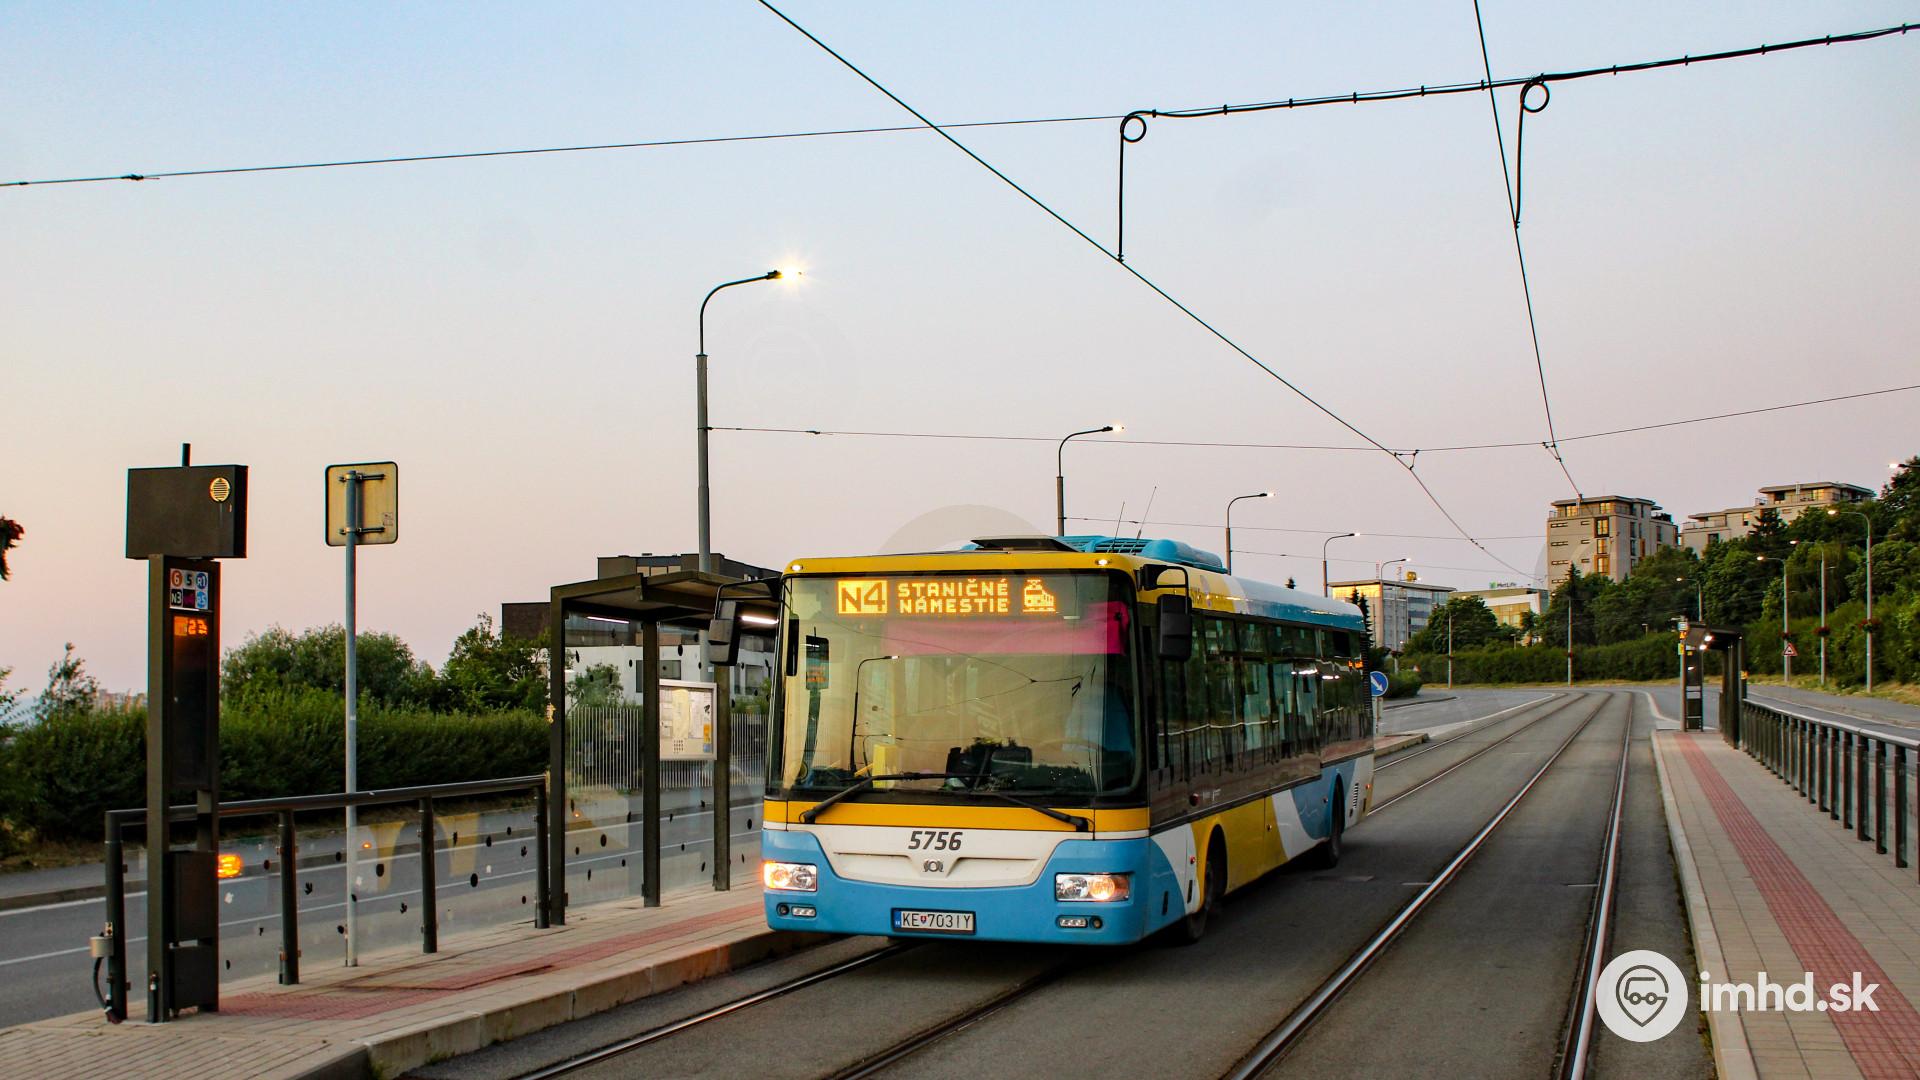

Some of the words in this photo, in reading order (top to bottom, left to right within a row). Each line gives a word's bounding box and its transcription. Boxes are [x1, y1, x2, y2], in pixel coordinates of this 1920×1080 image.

[897, 578, 1009, 597] STANIČNÉ
[171, 591, 182, 604] N3
[841, 582, 886, 612] N4
[899, 595, 1009, 613] NÁMESTIE
[908, 831, 963, 850] 5756
[903, 912, 920, 927] KE
